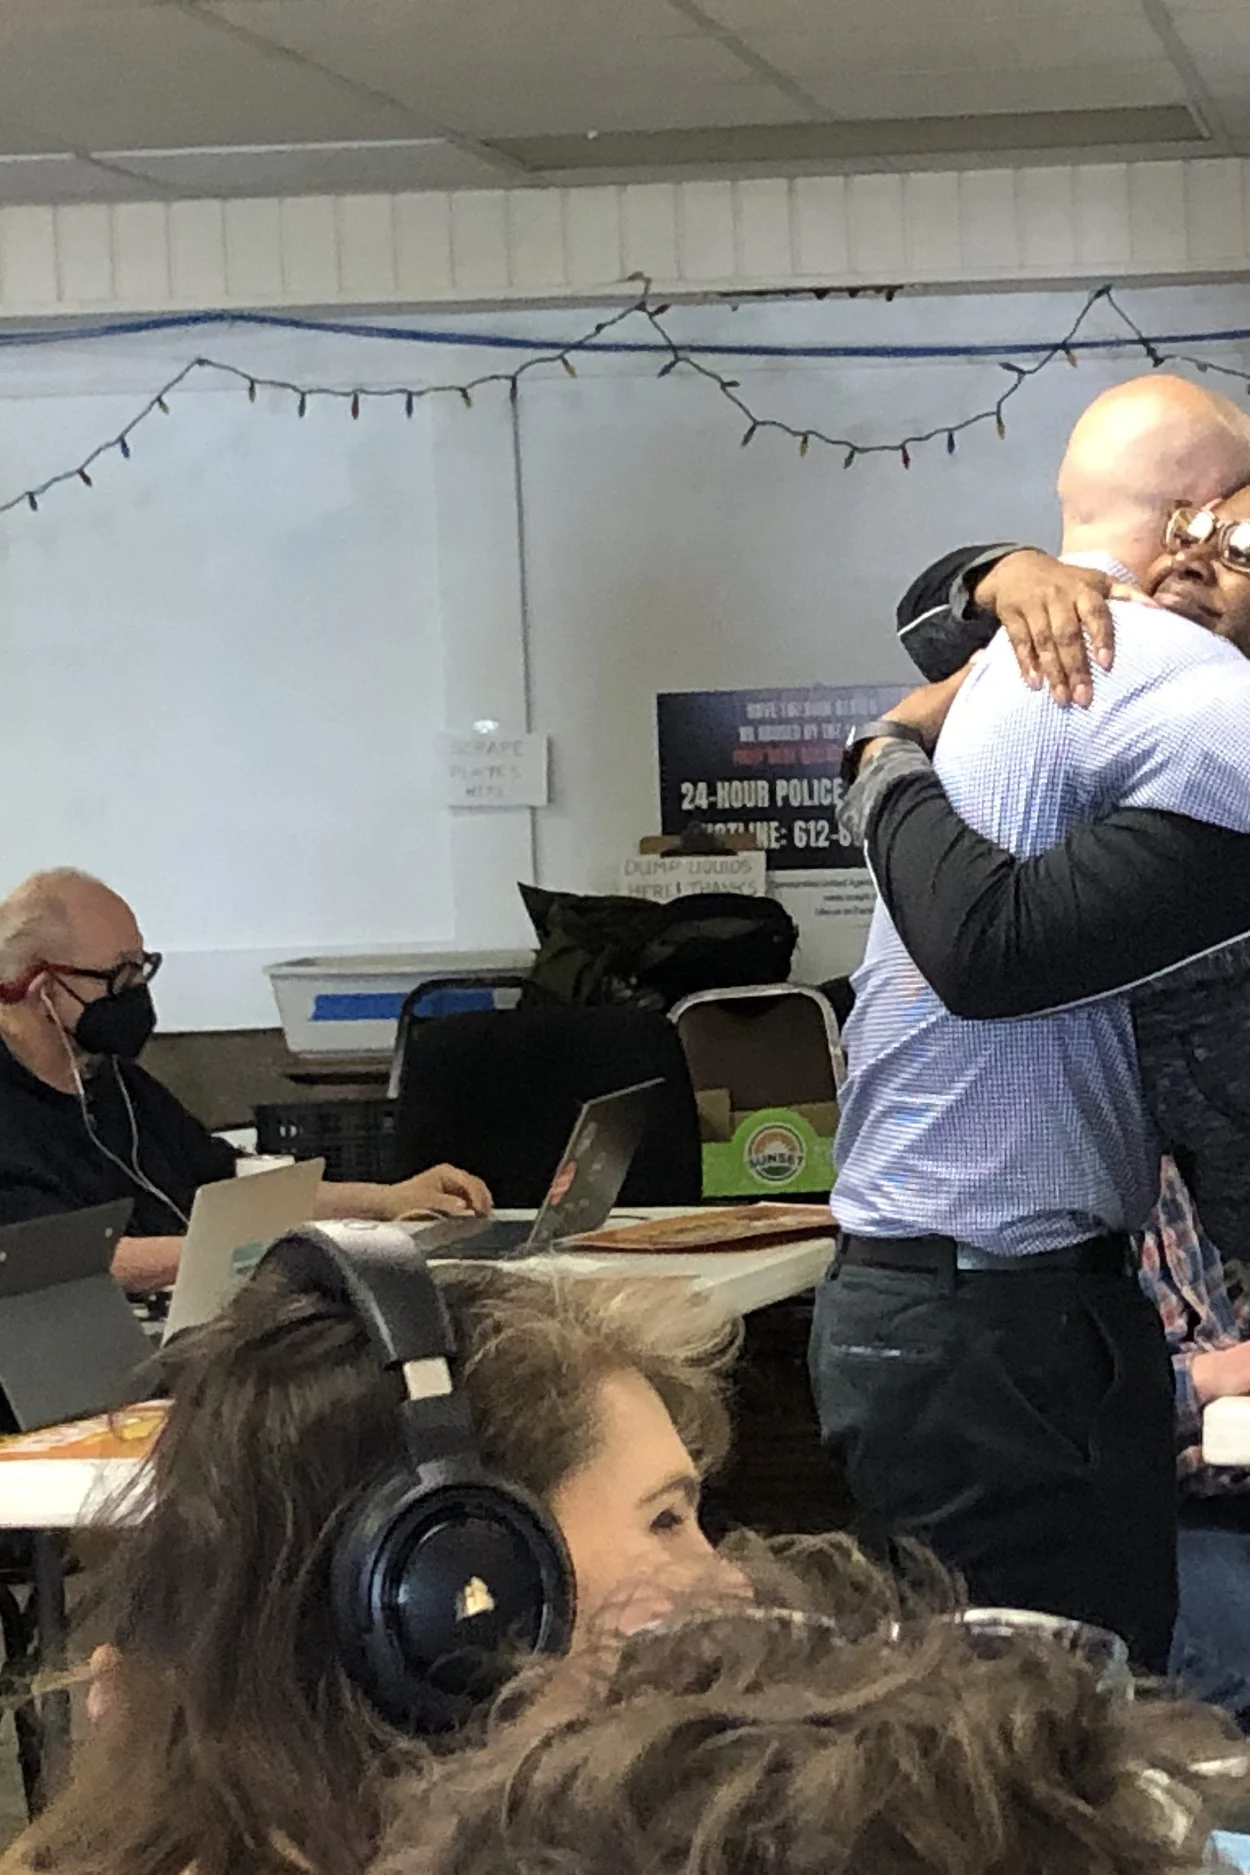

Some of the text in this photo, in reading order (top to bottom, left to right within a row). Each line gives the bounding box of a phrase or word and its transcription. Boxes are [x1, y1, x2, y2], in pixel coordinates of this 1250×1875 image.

[681, 777, 844, 811] 24-HOUR POLICE
[624, 858, 753, 876] DUMP LIQUIDS
[750, 1152, 805, 1169] SUNSET
